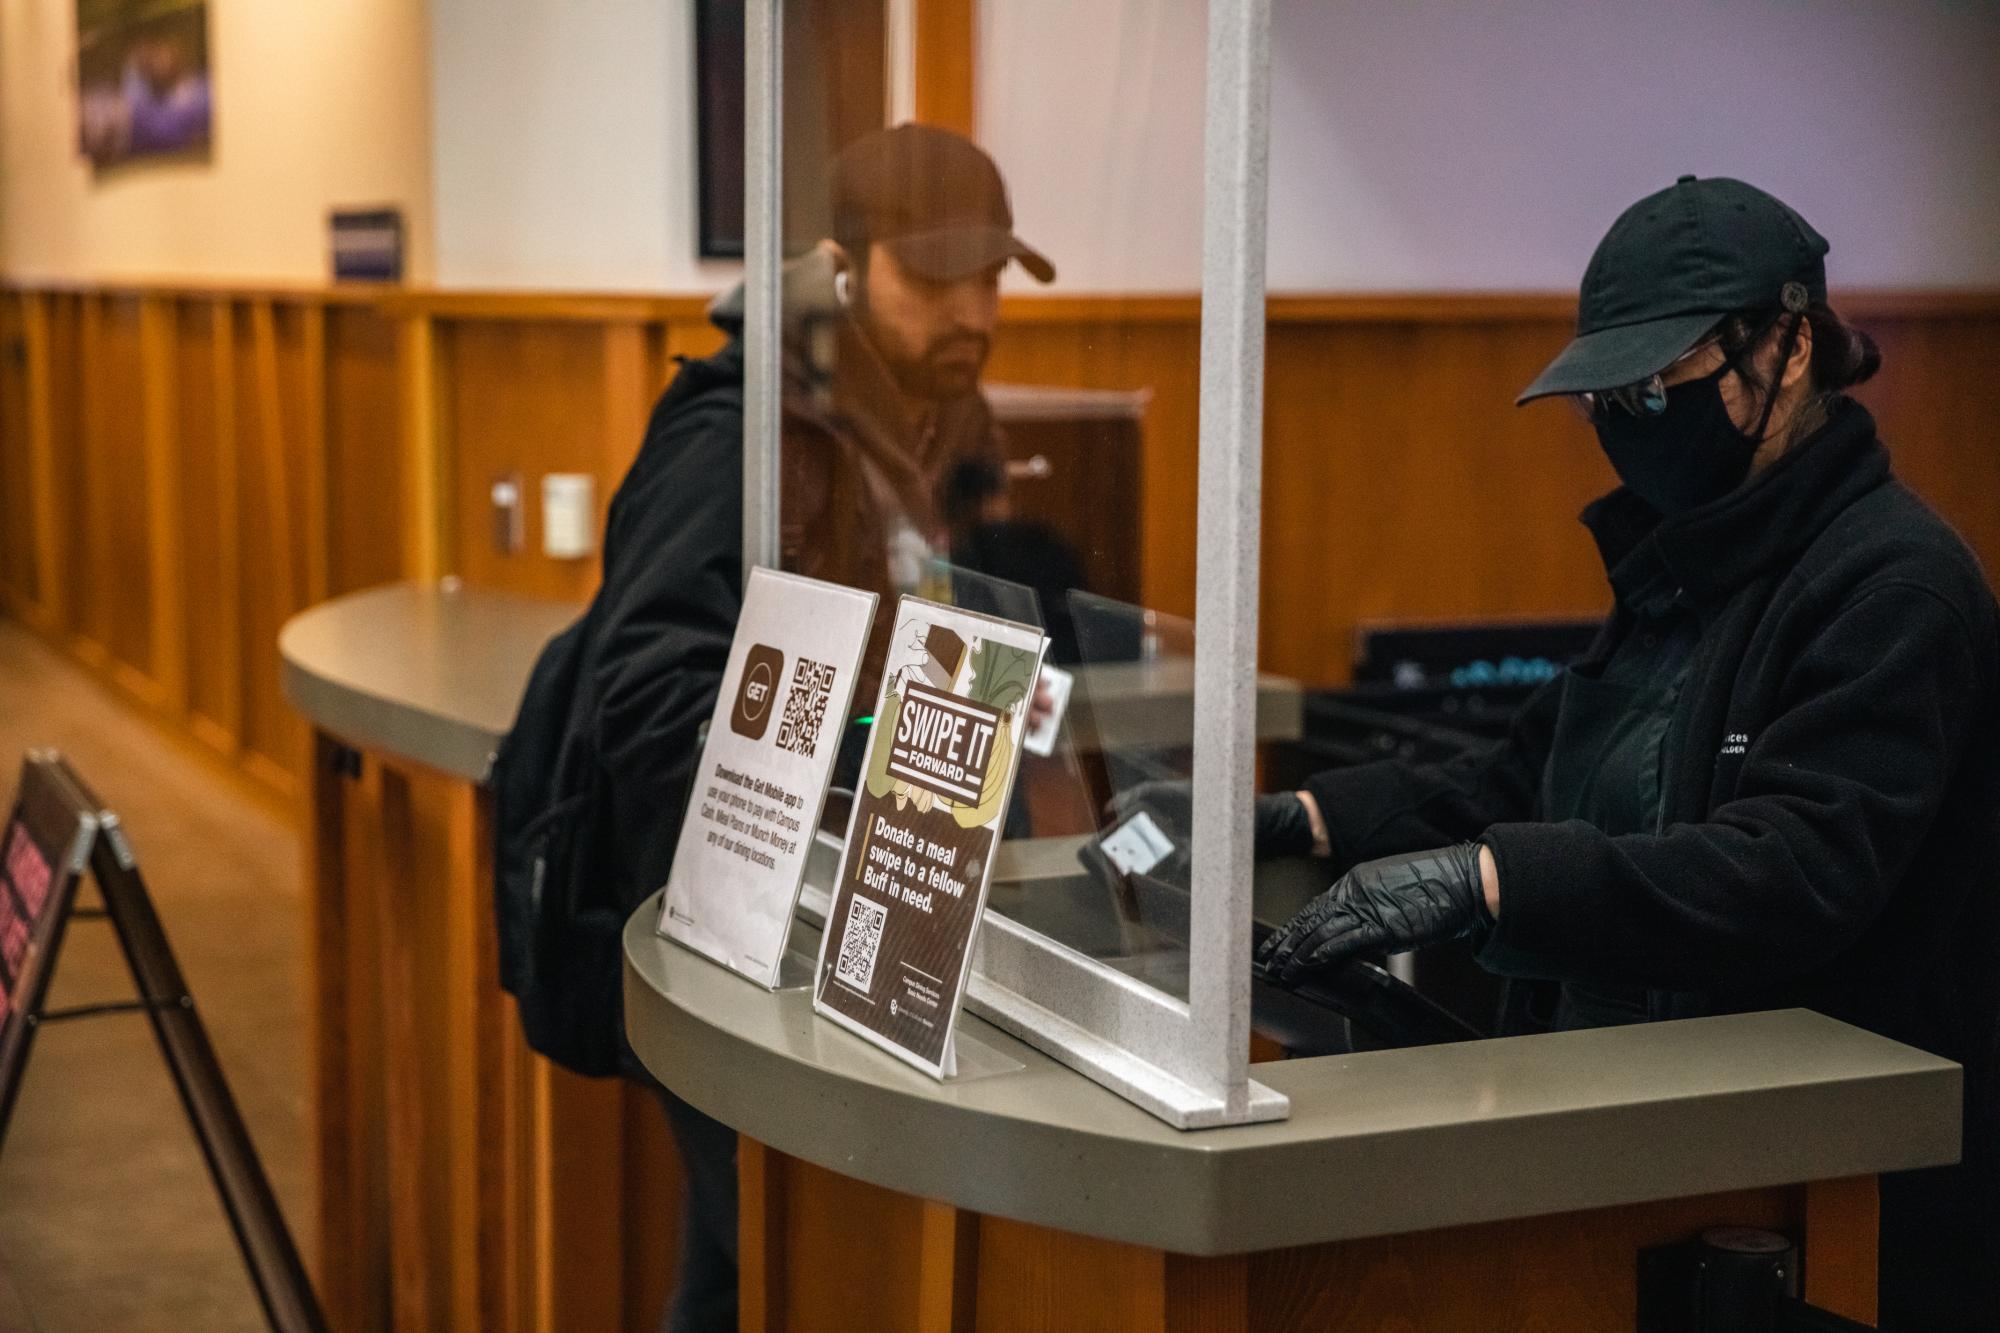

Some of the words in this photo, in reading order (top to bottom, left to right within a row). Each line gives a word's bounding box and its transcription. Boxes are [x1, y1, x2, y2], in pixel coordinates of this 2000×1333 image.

[747, 681, 768, 702] GET
[898, 700, 967, 761] SWIPE
[966, 722, 994, 769] IT
[715, 763, 744, 786] Download
[743, 775, 754, 790] the
[753, 778, 765, 794] Get
[764, 782, 785, 802] Mobile
[784, 793, 797, 809] app
[796, 795, 804, 809] to
[908, 750, 964, 782] FORWARD
[769, 831, 789, 854] Money
[788, 841, 797, 855] at
[776, 810, 801, 832] Campus
[875, 816, 915, 849] Donate
[916, 838, 925, 854] a
[926, 841, 957, 867] meal
[863, 865, 889, 892] Buff
[888, 876, 900, 899] in
[901, 887, 933, 914] need.
[869, 845, 901, 871] swipe
[904, 856, 916, 877] to
[917, 866, 926, 882] a
[928, 865, 966, 898] fellow
